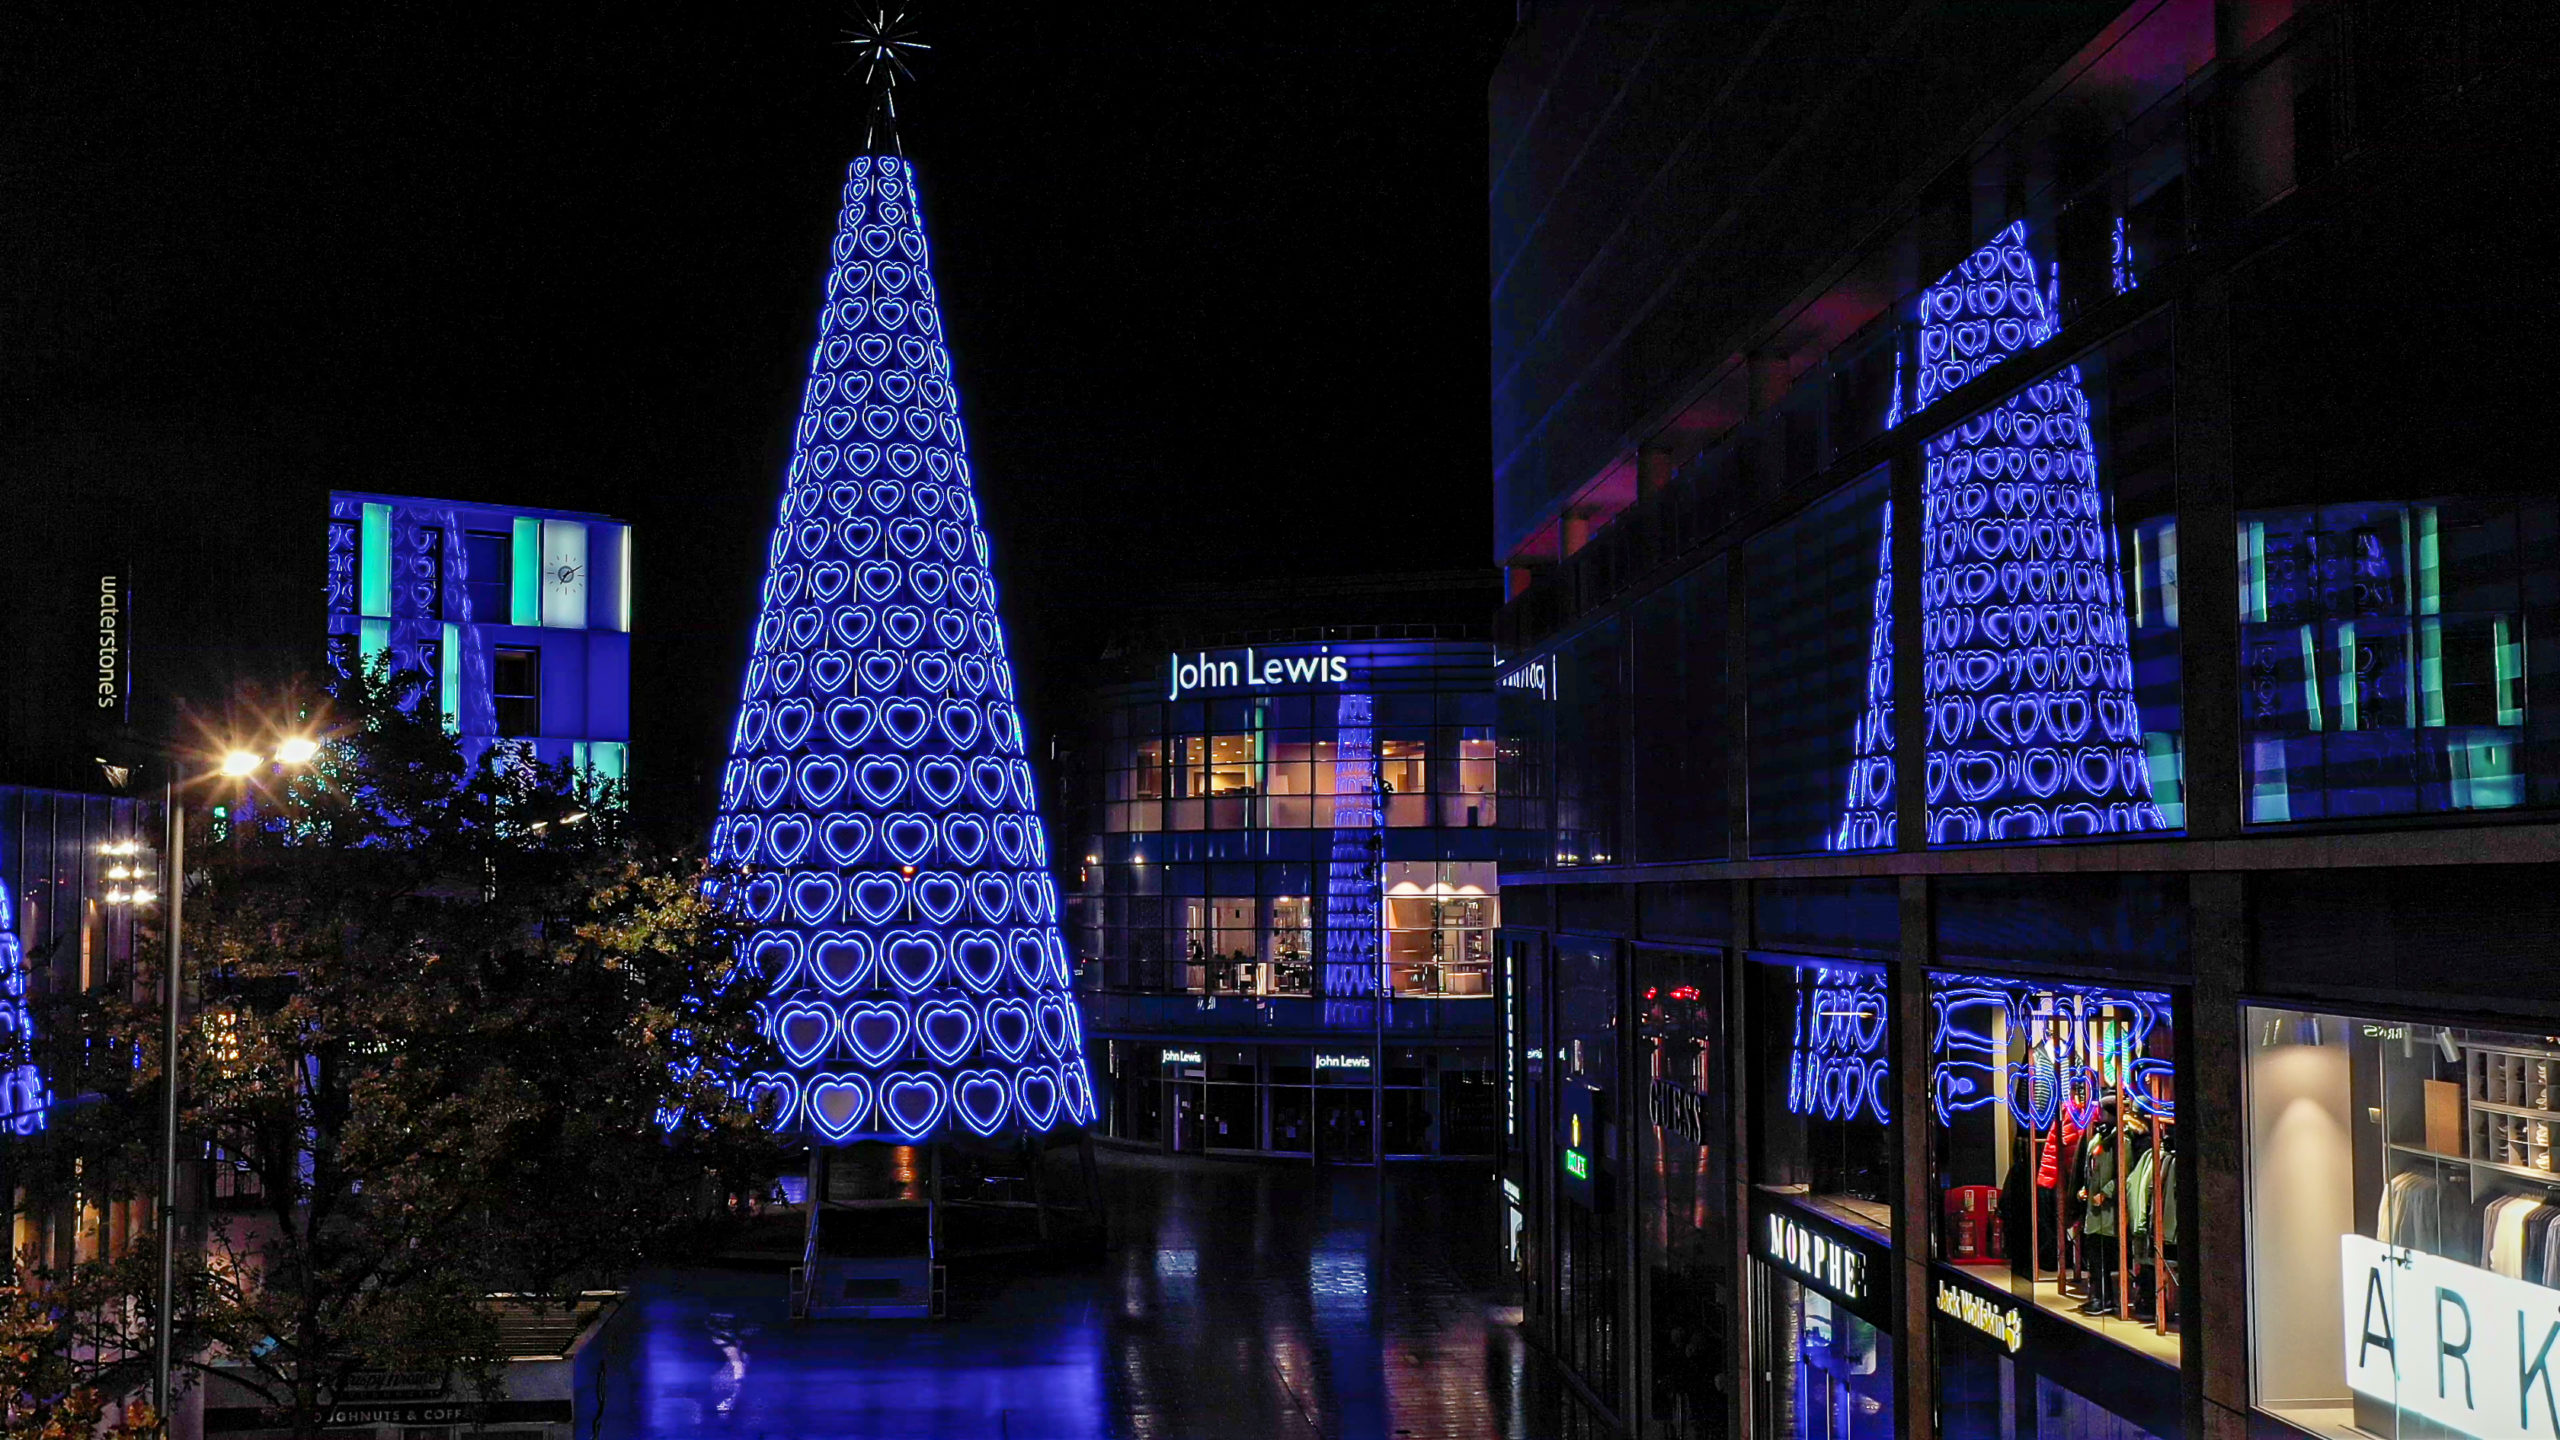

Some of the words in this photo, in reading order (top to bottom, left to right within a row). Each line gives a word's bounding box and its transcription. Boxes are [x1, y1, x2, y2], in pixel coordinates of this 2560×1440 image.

[98, 576, 119, 707] waterstone's
[1169, 652, 1238, 701] John
[1248, 646, 1348, 685] Lewis
[1162, 1049, 1179, 1063] John
[1180, 1050, 1202, 1063] Lewis
[1316, 1054, 1339, 1069] John
[1341, 1055, 1370, 1068] Lewis
[1650, 1078, 1701, 1146] GUESS
[1768, 1212, 1859, 1298] MORPHE
[1936, 1280, 1961, 1319] Jack
[1960, 1289, 2006, 1342] Wolfskin
[2359, 1266, 2560, 1440] ARK
[406, 1411, 417, 1421] &
